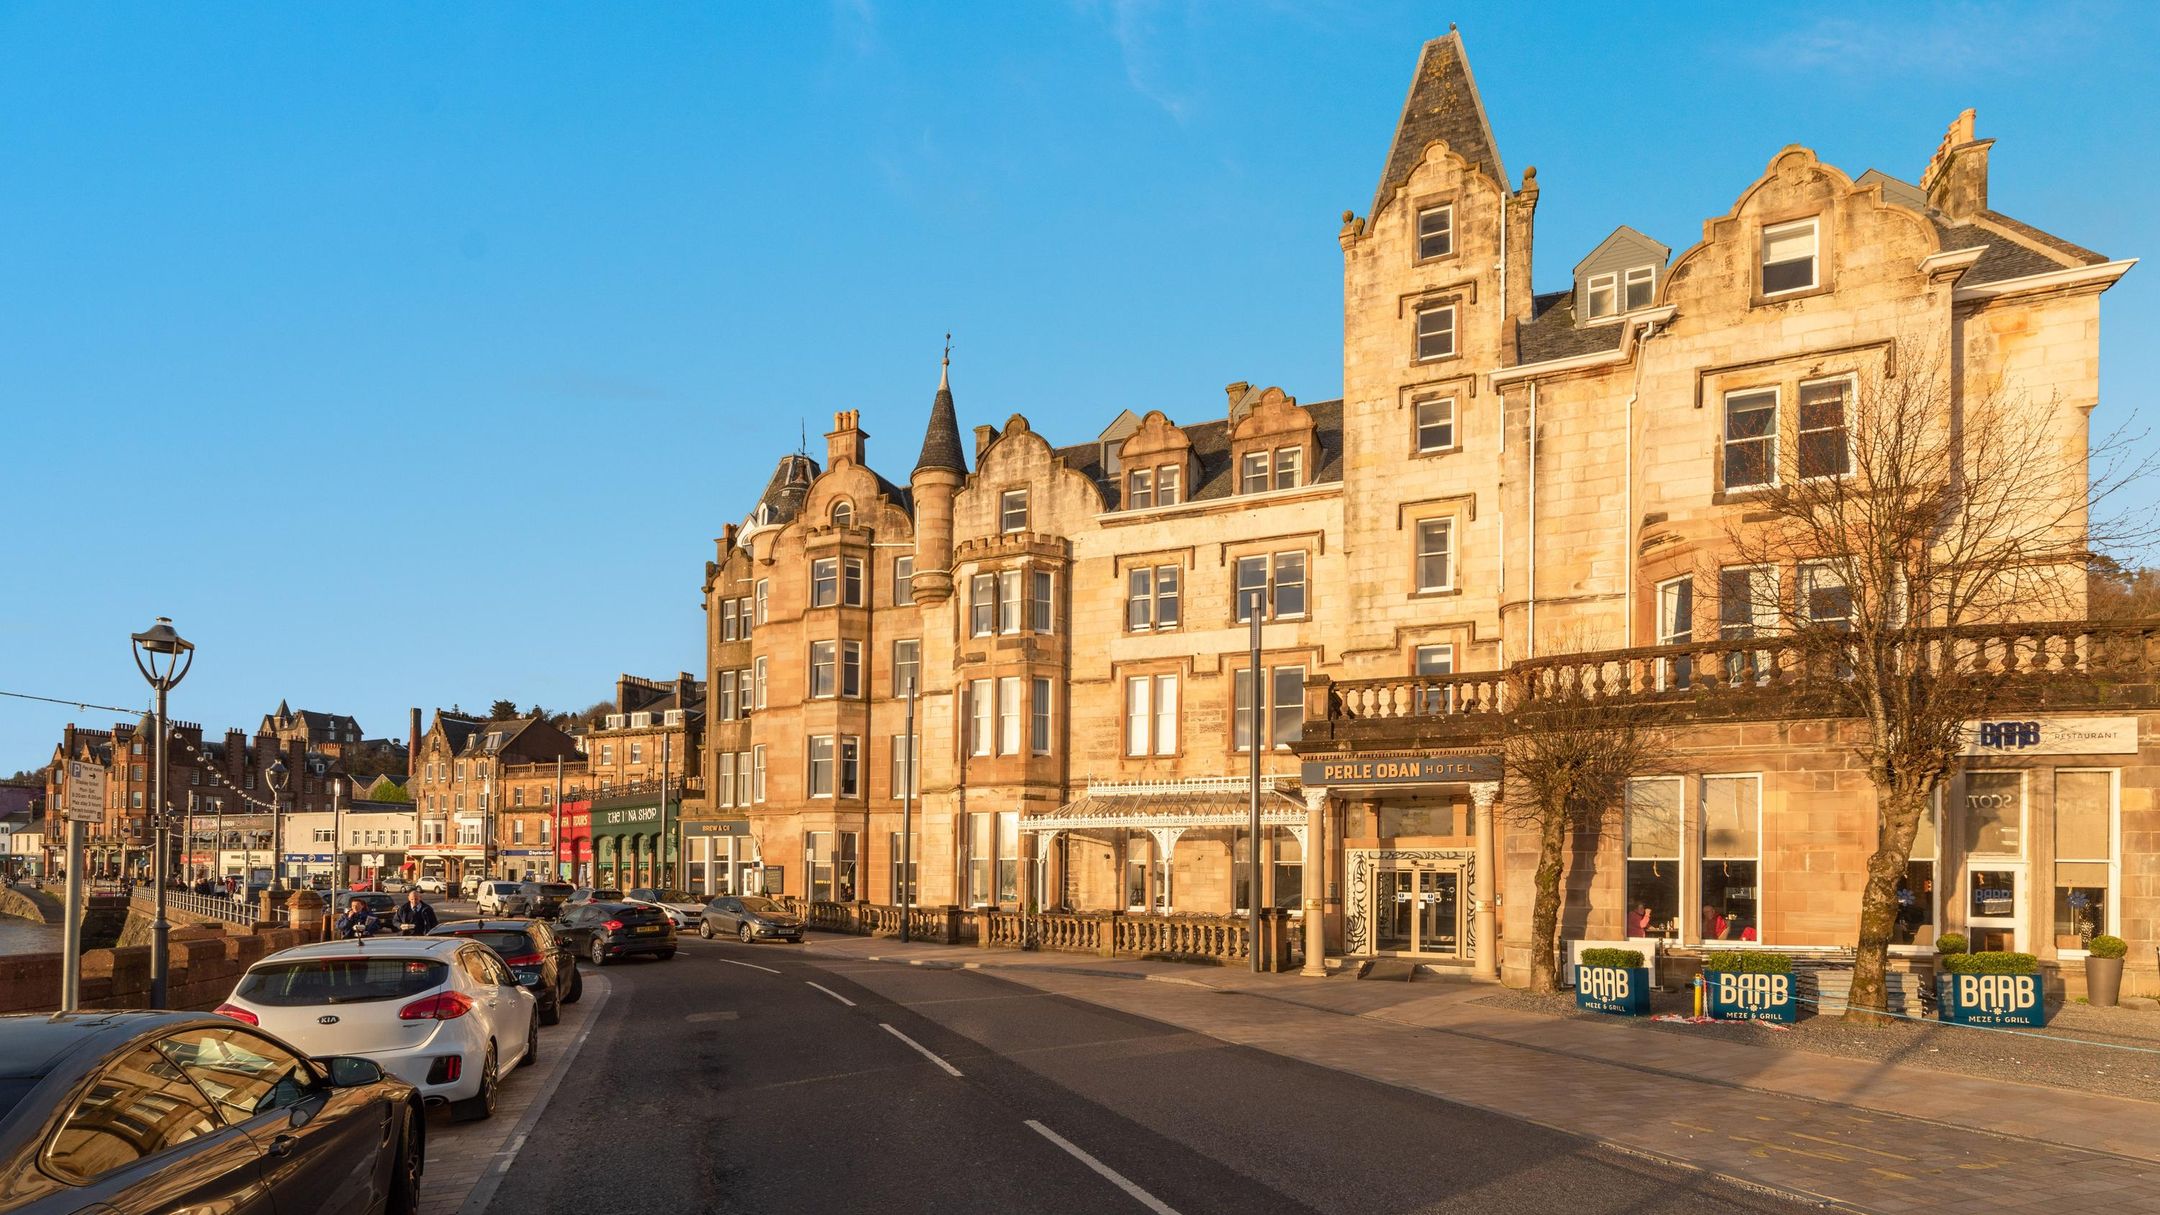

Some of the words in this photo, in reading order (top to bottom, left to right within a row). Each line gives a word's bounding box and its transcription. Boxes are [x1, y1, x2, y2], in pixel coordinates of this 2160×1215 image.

[2054, 732, 2118, 740] RESTAURANT
[1324, 764, 1372, 780] PERLE
[1376, 763, 1420, 779] OBAN
[1425, 764, 1474, 774] HOTEL
[555, 816, 569, 827] SFFA
[573, 815, 588, 826] TOURS
[622, 810, 637, 822] INA
[638, 808, 657, 821] SHOP
[1580, 966, 1629, 1001] BAAB
[1720, 973, 1788, 1009] BAAB
[1960, 975, 2035, 1012] BAAB
[321, 1016, 337, 1024] KIA
[2005, 1016, 2030, 1024] GRILL
